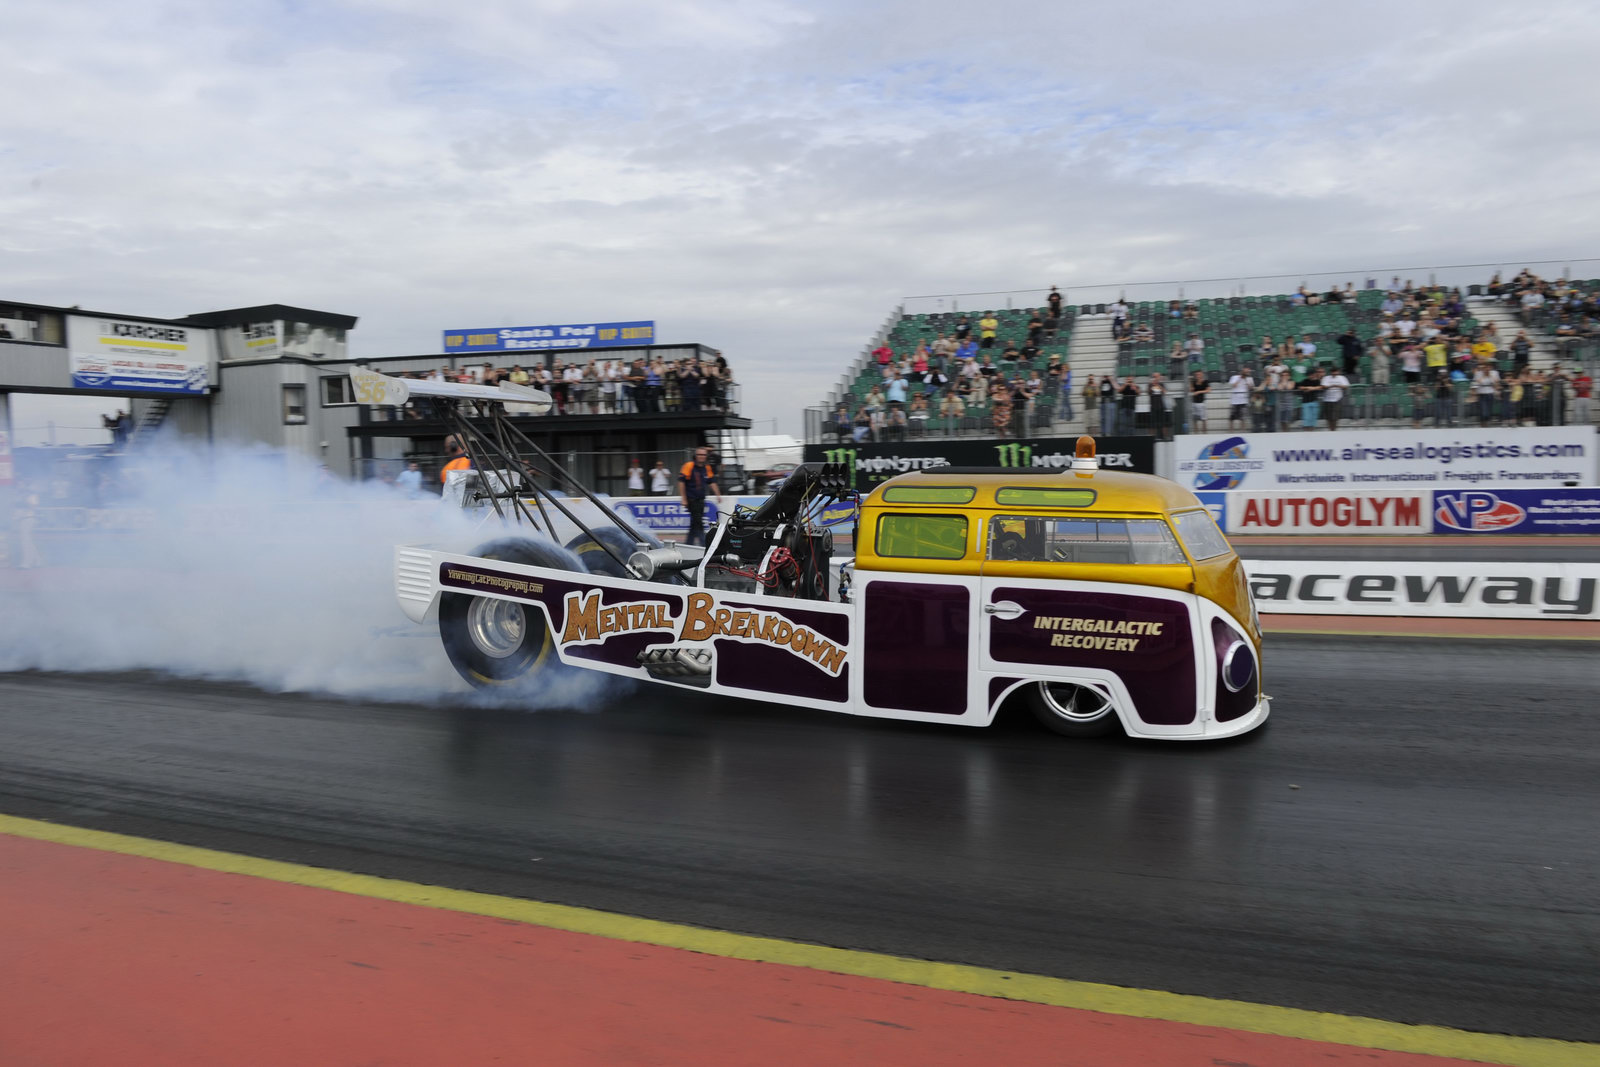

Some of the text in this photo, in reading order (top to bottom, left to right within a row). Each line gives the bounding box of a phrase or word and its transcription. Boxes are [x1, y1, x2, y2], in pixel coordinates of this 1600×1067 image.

[499, 326, 596, 339] Santa Pod
[504, 338, 591, 349] Raceway
[358, 382, 387, 403] 56
[1032, 452, 1134, 468] MONTER
[1273, 441, 1585, 463] www.airsealogistics.com
[1276, 469, 1582, 484] Worldwide International Freight Forwarders
[1242, 497, 1421, 527] AUTOGLYM
[1436, 492, 1500, 529] VP
[1250, 573, 1597, 615] aceway
[560, 592, 847, 674] MENTAL BREAKDOWN
[1034, 616, 1163, 636] INTERGALACTIC
[1050, 633, 1140, 652] RECOVERY
